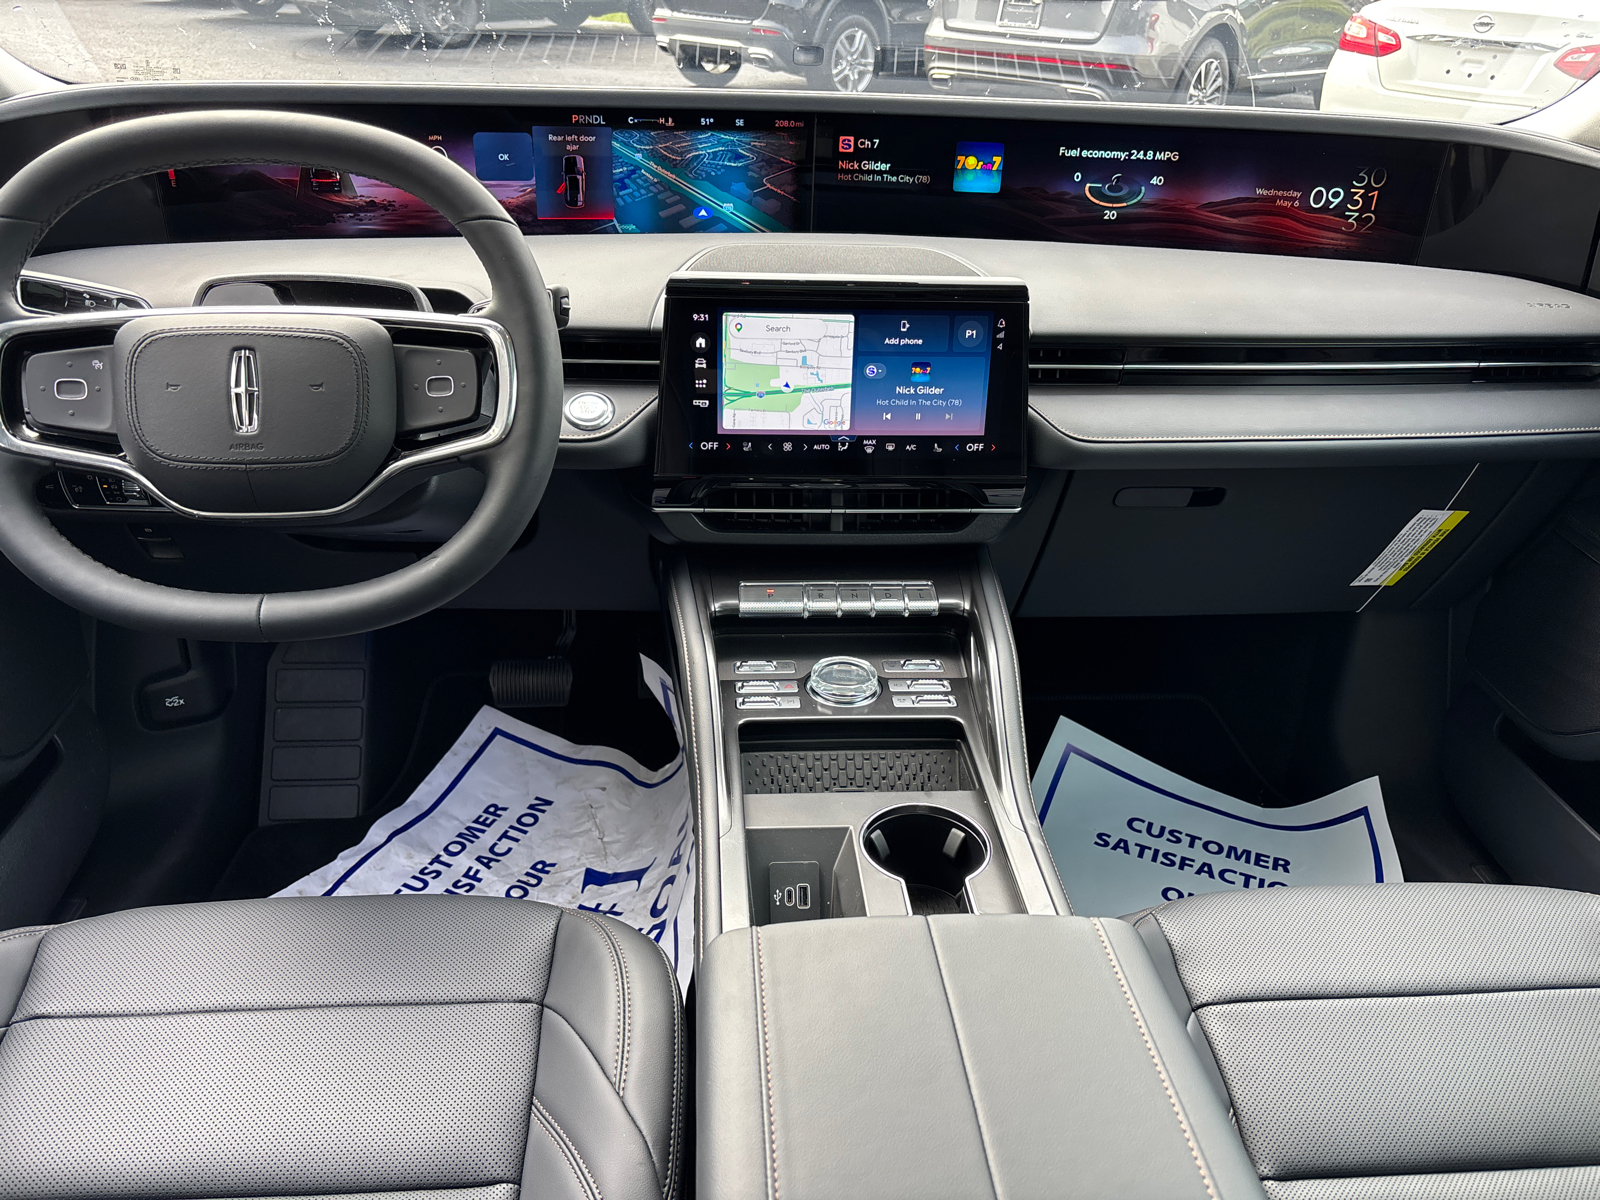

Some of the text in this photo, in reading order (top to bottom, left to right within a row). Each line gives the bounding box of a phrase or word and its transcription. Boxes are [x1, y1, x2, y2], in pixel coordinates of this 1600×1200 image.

[572, 115, 606, 125] PRNDL
[775, 120, 795, 128] 208.0
[548, 134, 564, 142] Rear
[579, 135, 597, 143] door
[566, 143, 580, 151] ajar
[857, 139, 880, 149] Ch 7
[498, 153, 510, 161] OK
[1059, 147, 1180, 161] Fuel economy: 24.8 MPG
[838, 161, 892, 171] Nick Gilder
[837, 173, 931, 185] Hot Child In The City (78)
[1074, 172, 1082, 182] 0
[1150, 176, 1164, 186] 40
[1352, 166, 1388, 188] 30
[1255, 188, 1303, 198] Wednesday
[1275, 199, 1293, 208] May
[1310, 186, 1379, 211] 09 31
[1103, 210, 1118, 220] 20
[1341, 211, 1377, 234] 32
[692, 313, 709, 321] 9:31
[765, 324, 791, 333] Search
[965, 330, 977, 339] P1
[884, 337, 923, 346] Add phone
[896, 386, 945, 395] Nick Gilder
[890, 398, 908, 406] Child
[932, 399, 947, 408] City
[947, 399, 963, 407] (78)
[823, 418, 846, 427] Google
[229, 442, 265, 451] AIRBAG
[700, 441, 719, 450] OFF
[966, 443, 985, 452] OFF
[441, 796, 554, 895] ISFACTION
[1126, 817, 1291, 874] CUSTOMER
[505, 860, 558, 900] OUR
